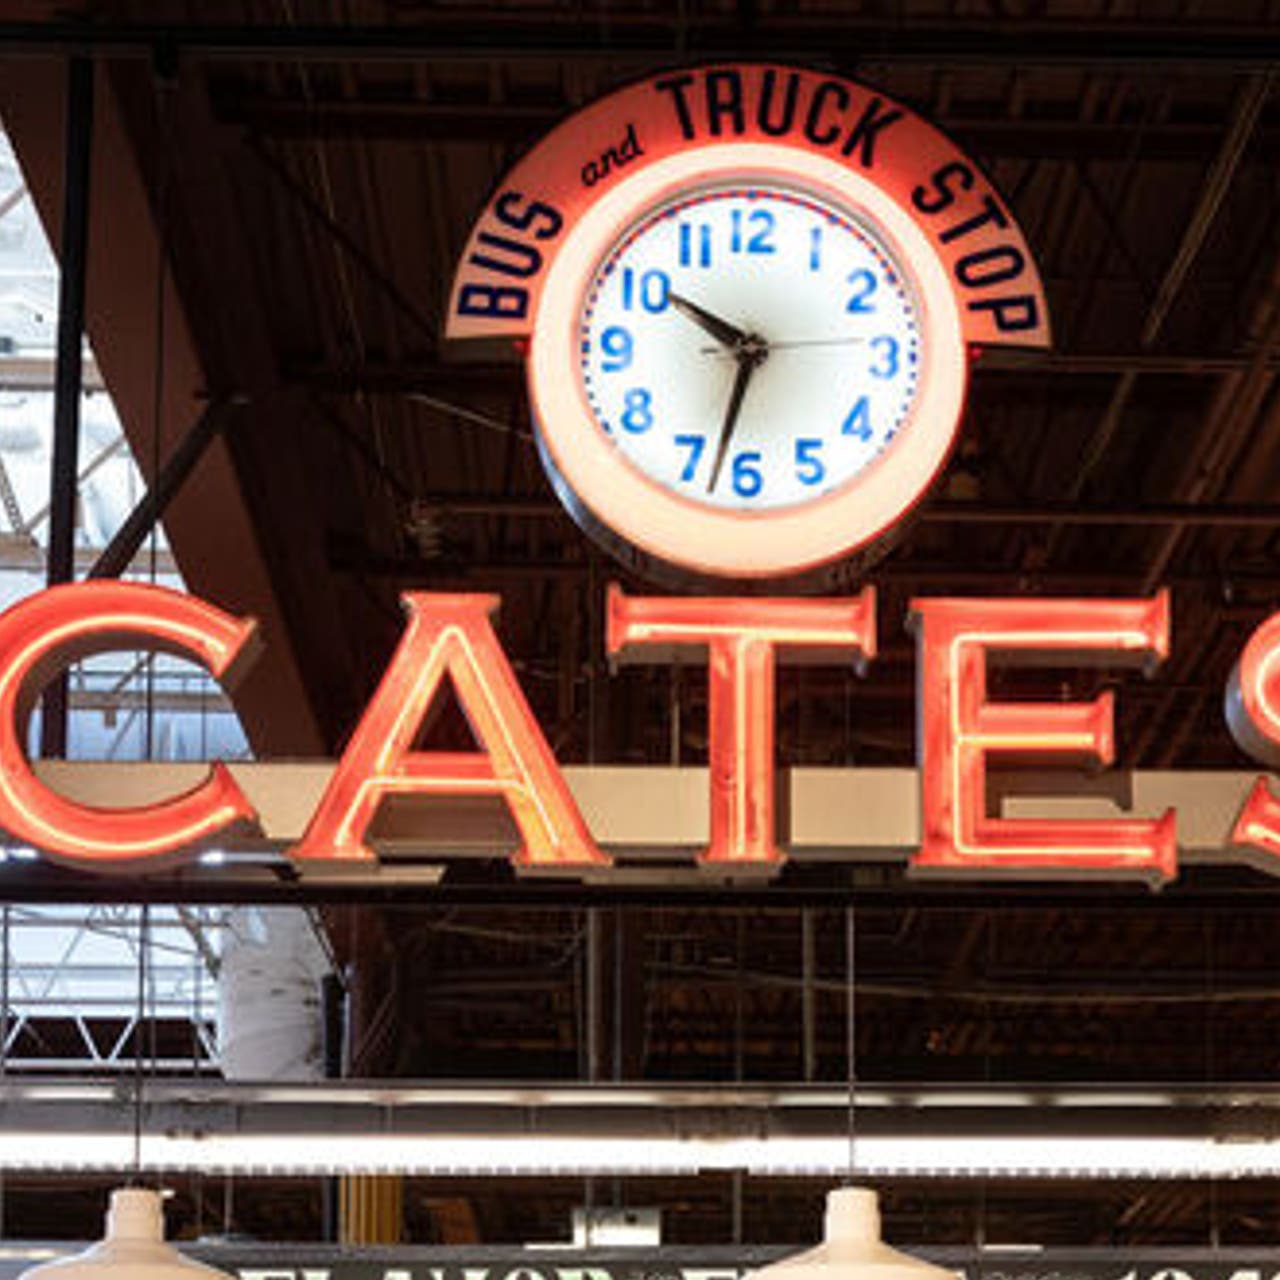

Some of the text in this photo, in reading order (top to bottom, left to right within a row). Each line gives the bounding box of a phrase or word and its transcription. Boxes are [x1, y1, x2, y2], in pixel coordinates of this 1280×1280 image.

[456, 69, 1040, 334] BUS and TRUCK STOP
[678, 223, 712, 268] 11
[730, 208, 777, 254] 12
[808, 226, 822, 270] 1
[621, 268, 671, 314] 10
[846, 270, 878, 314] 2
[600, 326, 633, 372] 9
[869, 337, 899, 380] 3
[620, 388, 654, 434] 8
[841, 396, 873, 442] 4
[673, 435, 705, 482] 7
[732, 452, 762, 497] 6
[795, 439, 824, 485] 5
